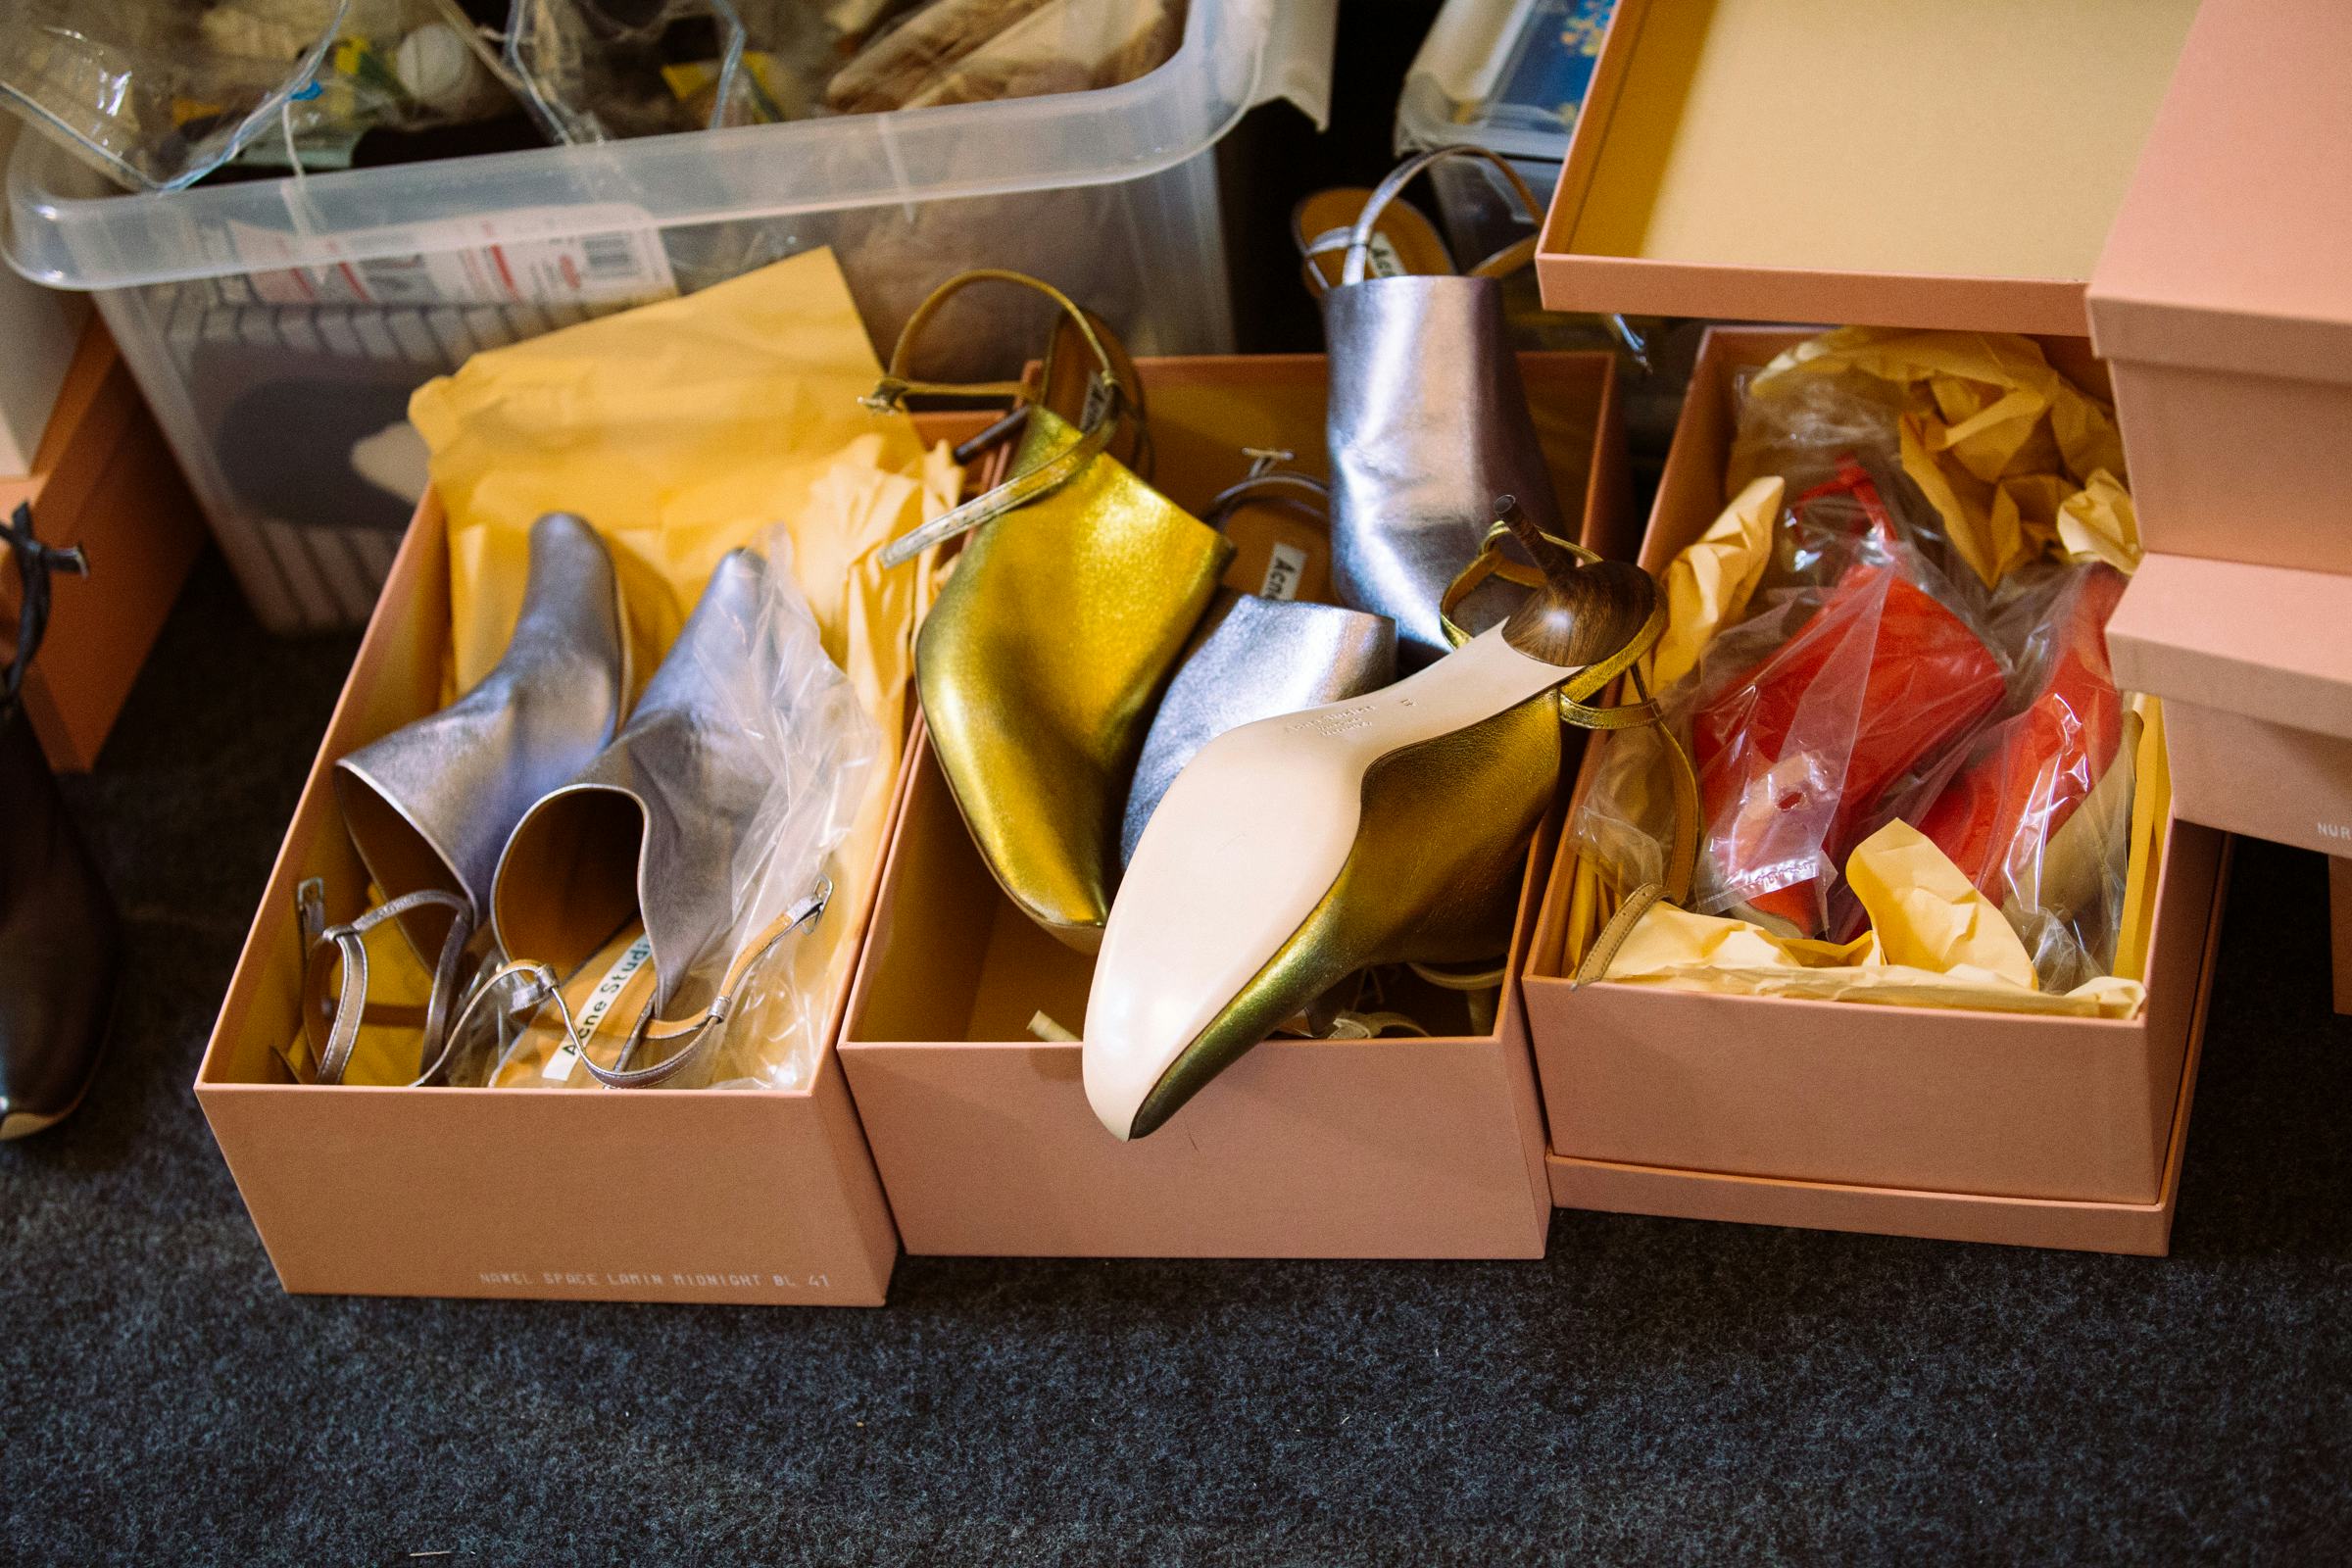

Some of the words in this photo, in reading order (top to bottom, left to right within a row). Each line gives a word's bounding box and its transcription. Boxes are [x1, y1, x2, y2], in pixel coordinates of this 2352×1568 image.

[562, 1000, 609, 1056] Acne
[542, 1272, 600, 1286] SPACE
[672, 1273, 762, 1288] MIDNIGHT
